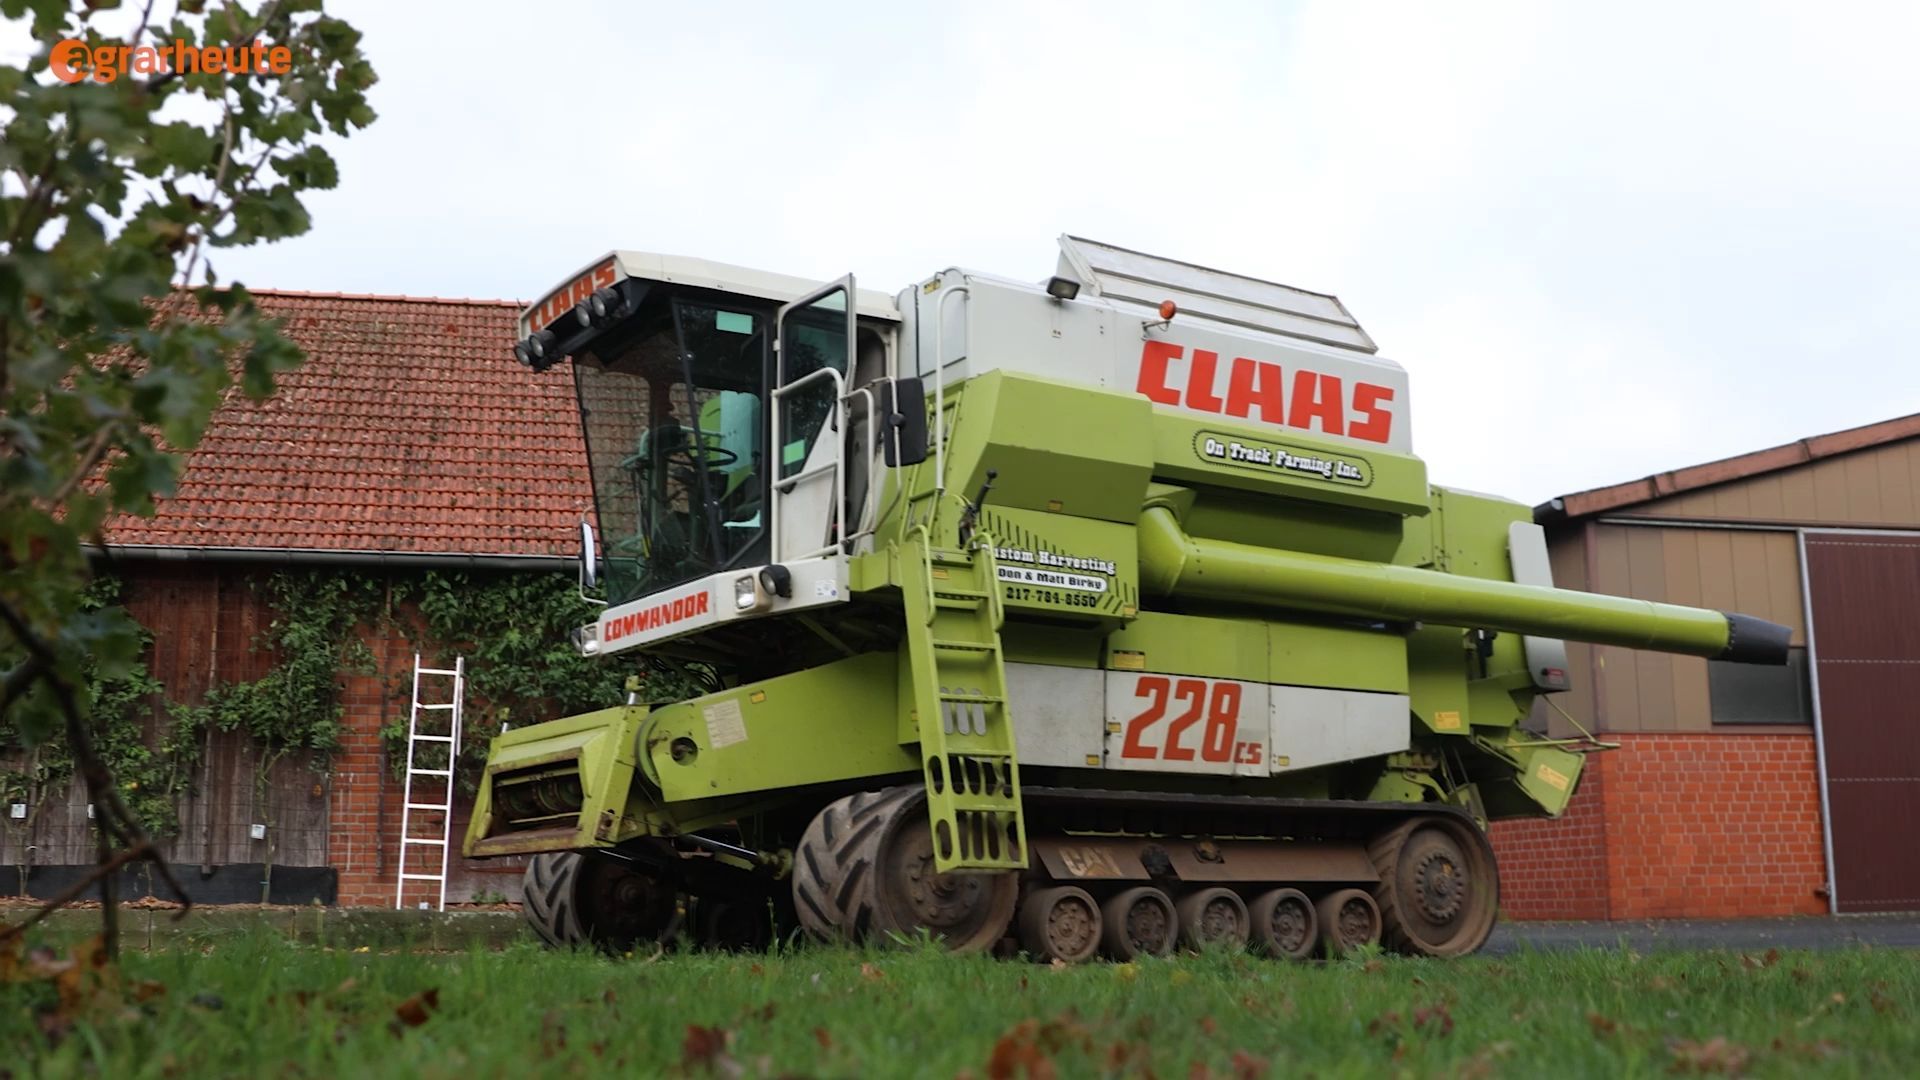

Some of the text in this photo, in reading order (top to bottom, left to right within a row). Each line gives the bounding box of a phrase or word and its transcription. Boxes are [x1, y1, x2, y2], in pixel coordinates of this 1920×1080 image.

[529, 260, 616, 333] CLAAS
[1136, 340, 1394, 443] CLAAS
[1205, 439, 1362, 480] On Track Farming Inc.
[998, 568, 1102, 589] Don & Matt Birky
[1038, 550, 1116, 575] Harvesting
[604, 591, 709, 642] COMMANDOR
[1121, 676, 1262, 765] 228 CS
